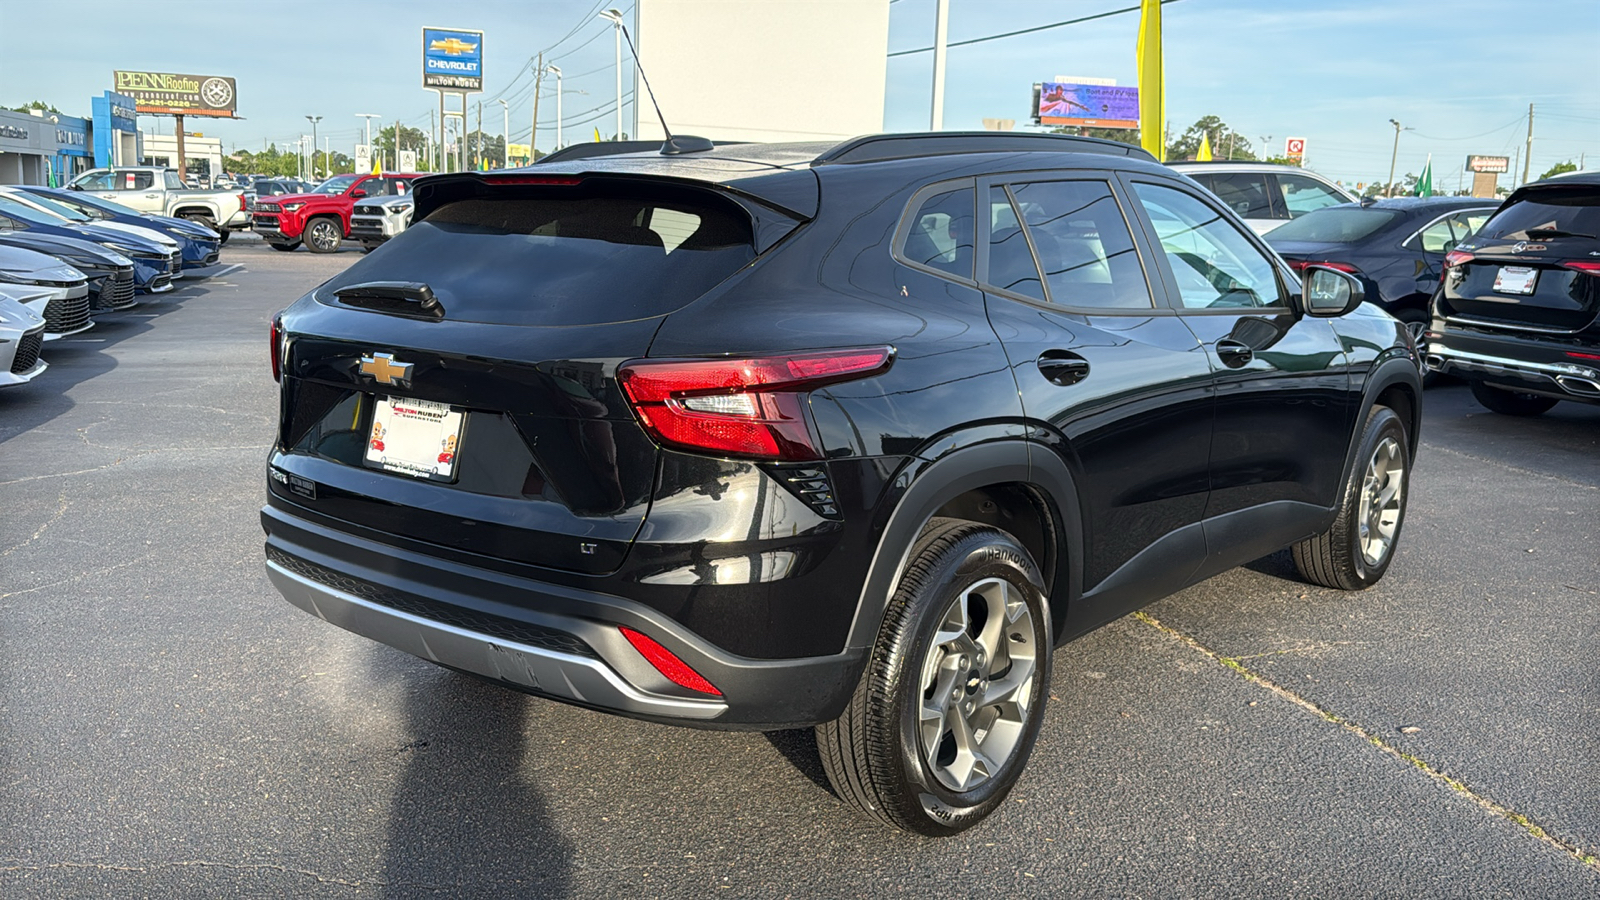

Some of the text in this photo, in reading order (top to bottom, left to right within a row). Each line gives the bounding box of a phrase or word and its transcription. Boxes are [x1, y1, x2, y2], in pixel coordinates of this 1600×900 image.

[428, 59, 478, 71] CHEVROLET
[117, 71, 169, 89] PENN
[166, 76, 199, 93] Roofing
[427, 77, 479, 88] MILTON RUBEN
[393, 407, 443, 419] MILTON RUBEN
[402, 414, 442, 424] SUPERSTORE
[580, 542, 598, 555] LT
[930, 803, 953, 821] HP2
